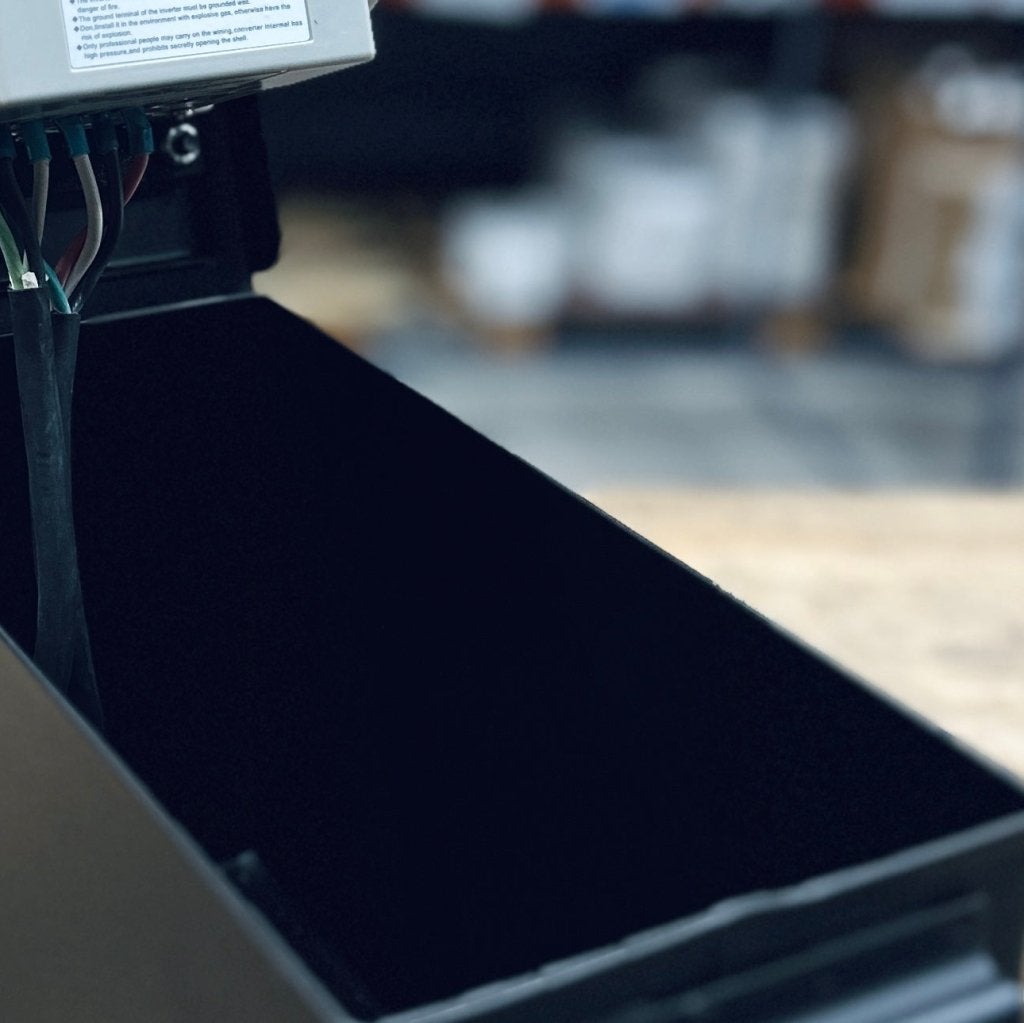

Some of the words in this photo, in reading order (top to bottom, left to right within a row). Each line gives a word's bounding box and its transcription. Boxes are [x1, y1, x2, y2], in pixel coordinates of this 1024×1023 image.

[92, 13, 113, 22] ground
[115, 10, 138, 18] terminal
[208, 0, 235, 9] grounded
[139, 16, 176, 24] environment
[191, 12, 218, 20] explosive
[99, 38, 136, 48] professional
[138, 36, 159, 44] people
[195, 39, 219, 47] opening
